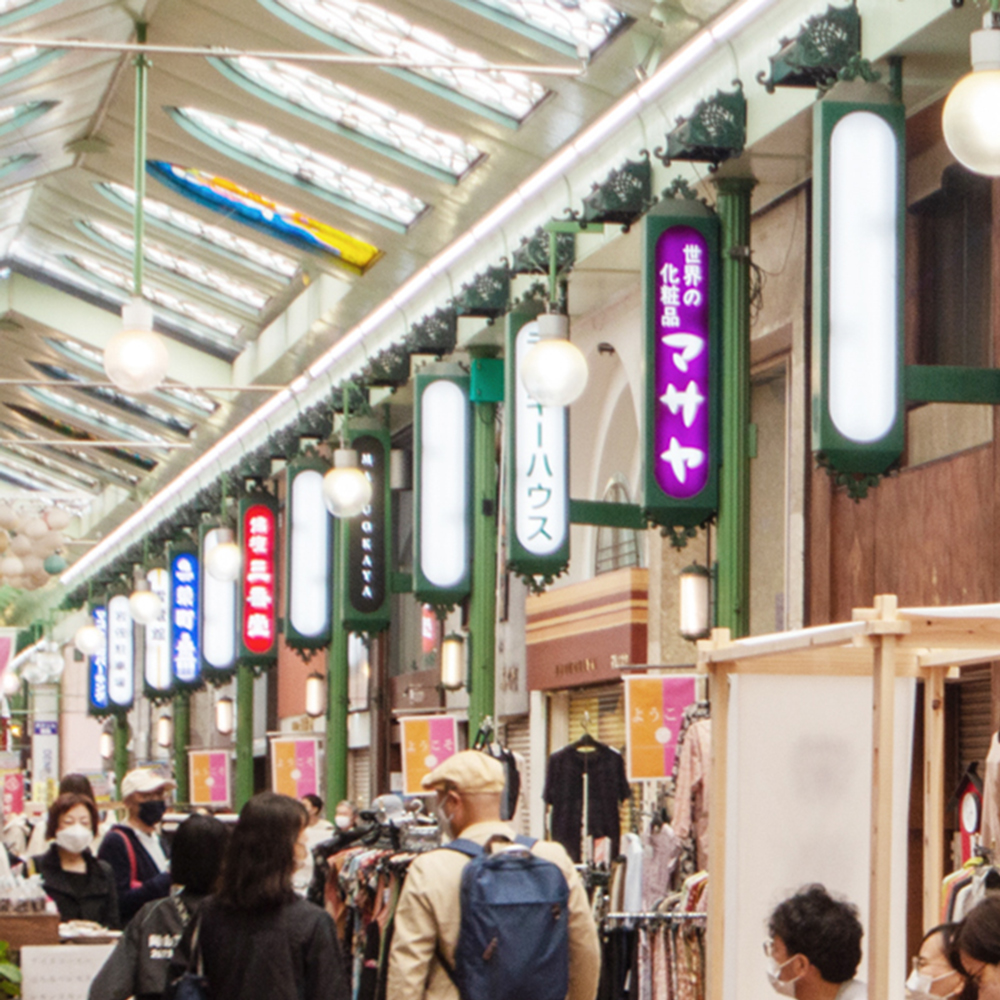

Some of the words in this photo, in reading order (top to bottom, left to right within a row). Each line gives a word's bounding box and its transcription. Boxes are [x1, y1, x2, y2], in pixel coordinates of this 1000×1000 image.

[659, 262, 681, 328] 化粧品
[682, 243, 702, 307] 世界の
[659, 332, 705, 484] マサヤ
